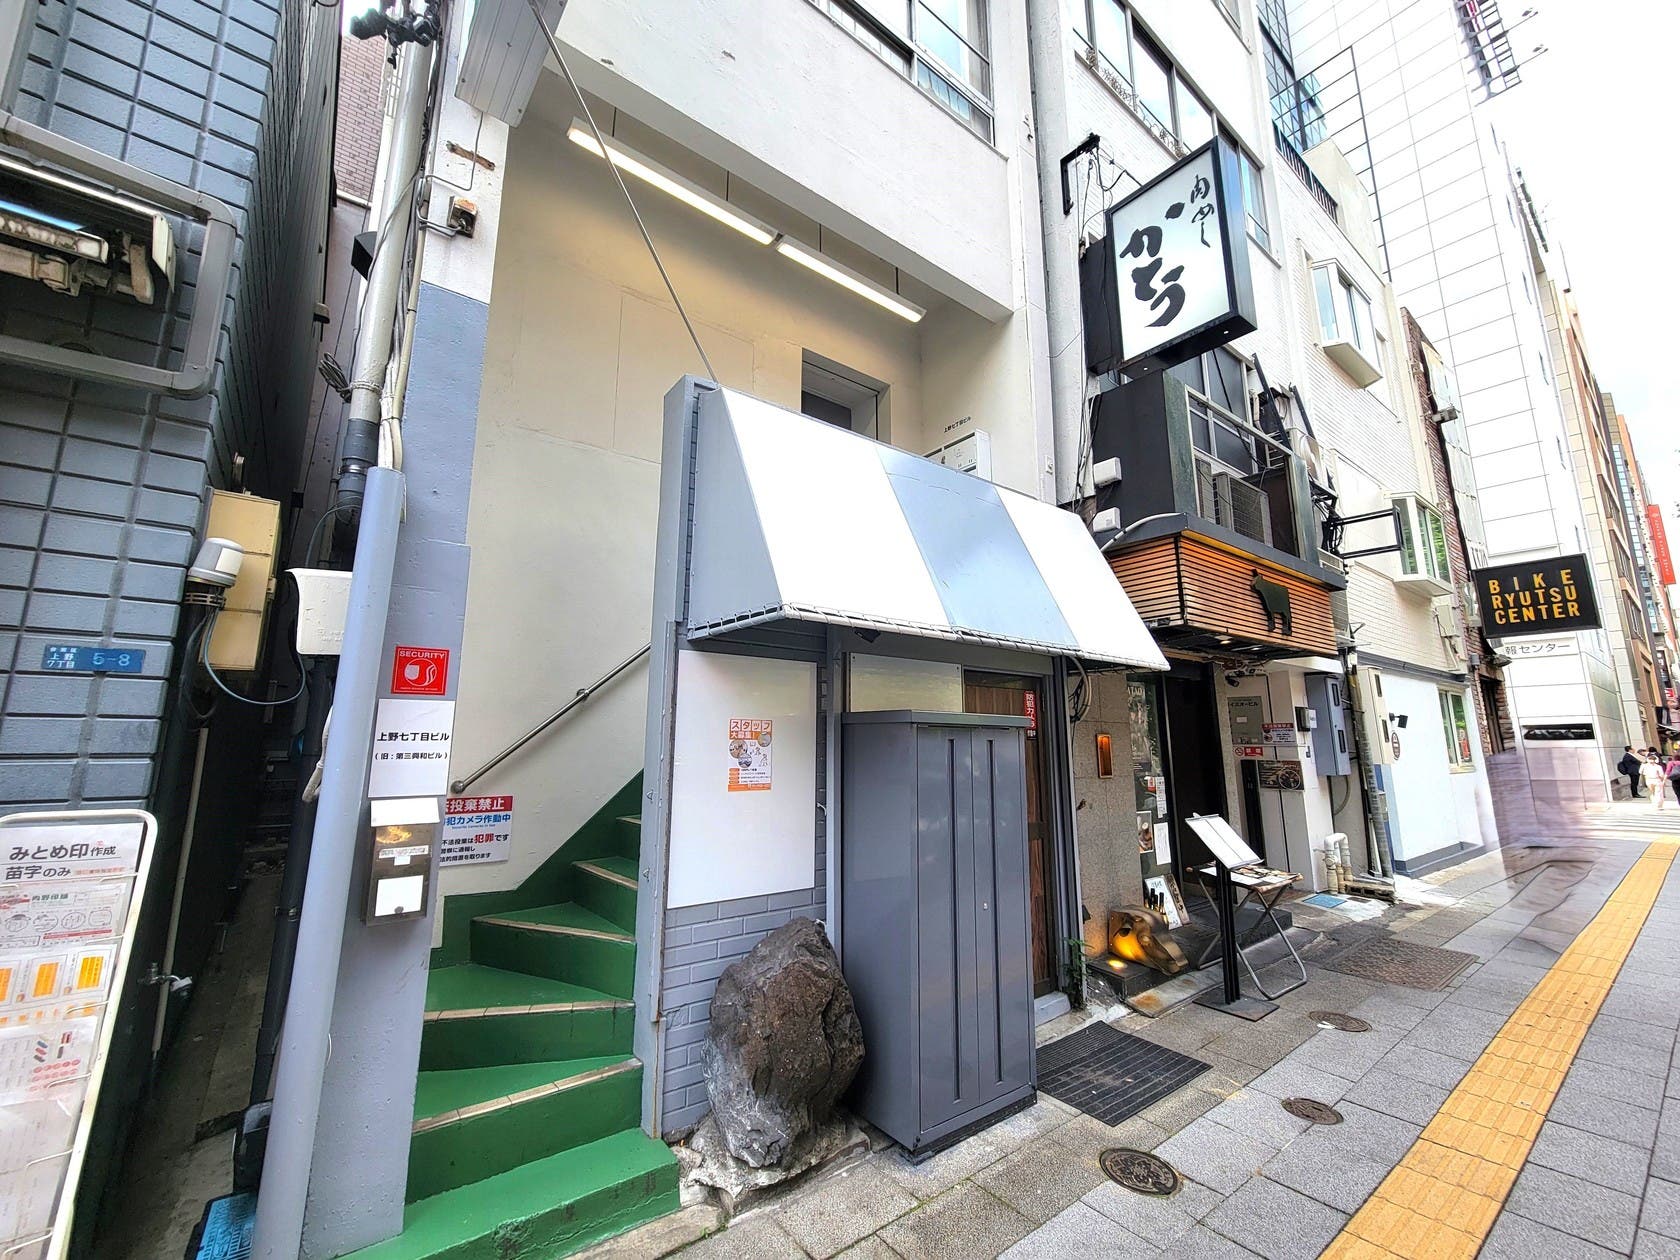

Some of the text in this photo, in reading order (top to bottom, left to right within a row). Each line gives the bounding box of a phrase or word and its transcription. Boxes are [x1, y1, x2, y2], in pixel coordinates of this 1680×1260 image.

[1488, 569, 1574, 594] BIKE
[1491, 585, 1577, 609] RYUTSU
[1494, 602, 1580, 624] CENTER
[399, 650, 445, 659] SECURITY
[731, 721, 771, 731] スタッフ
[377, 732, 449, 742] 上野七丁目ビル
[444, 814, 511, 826] 犯カメラ作動中
[9, 843, 117, 861] みとめ印作成
[5, 865, 72, 880] 苗字のみ
